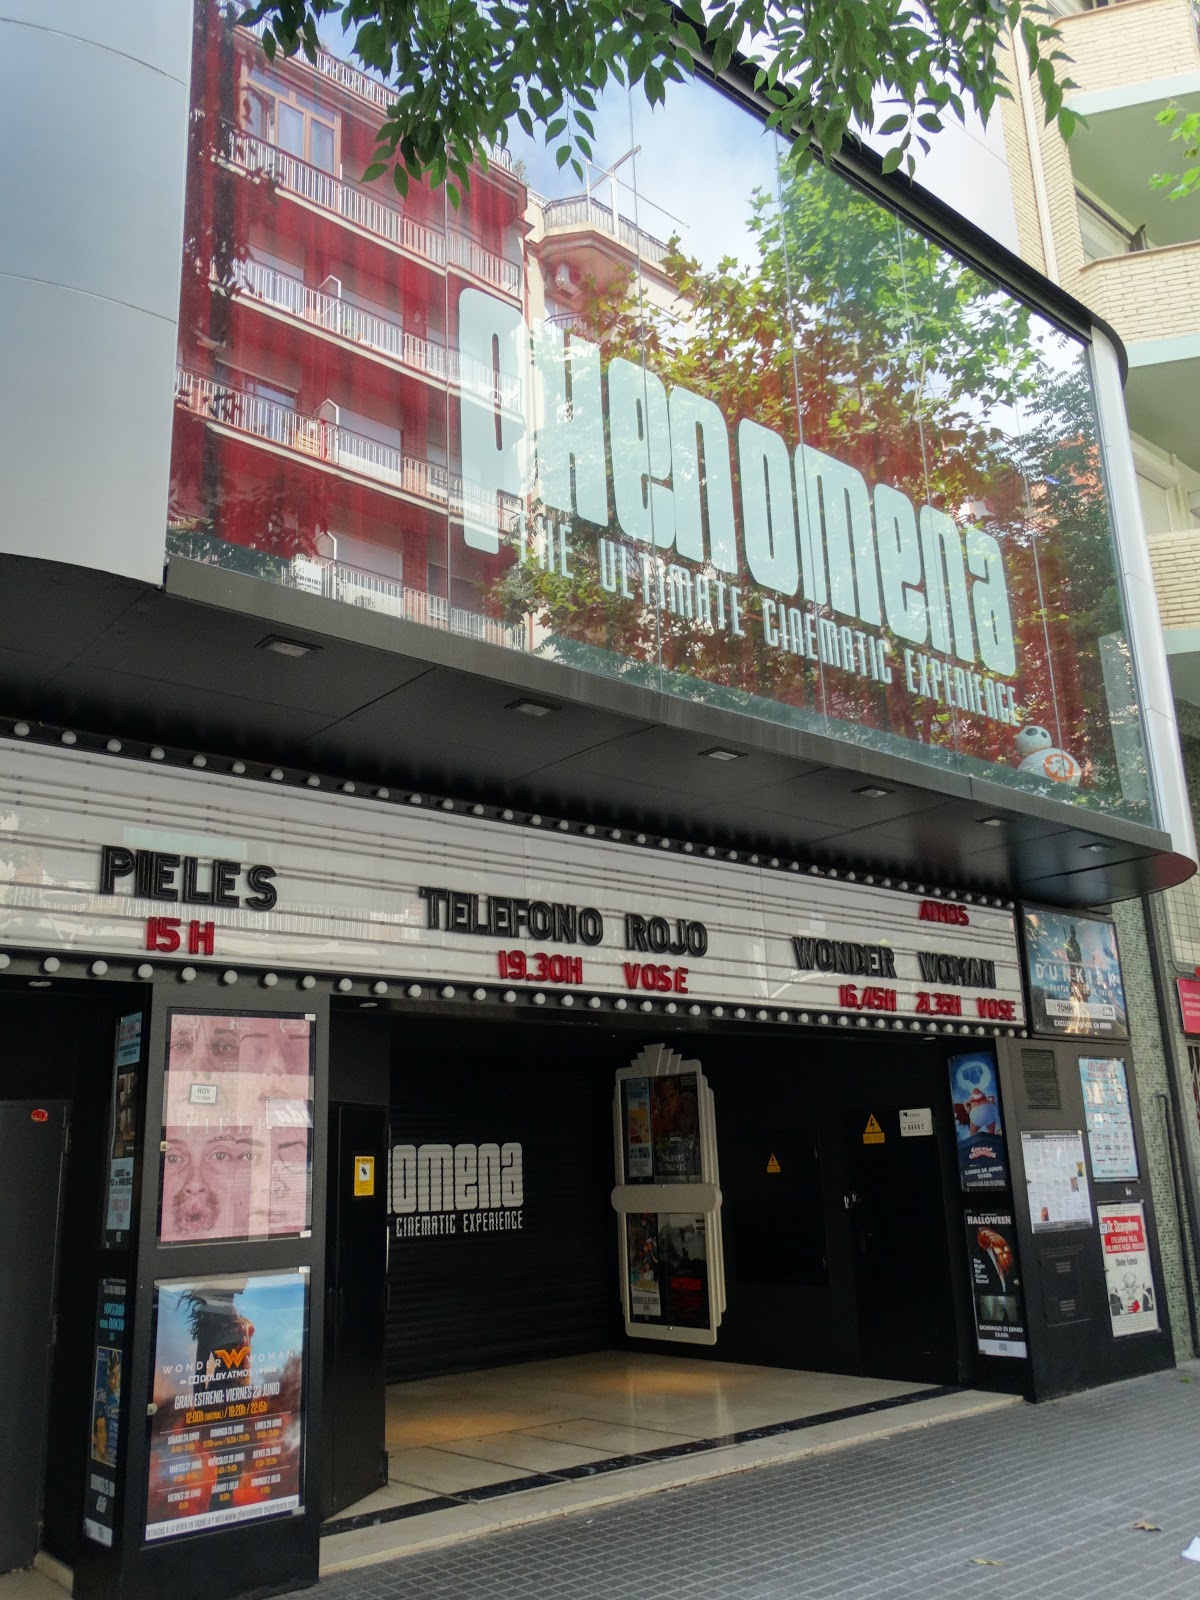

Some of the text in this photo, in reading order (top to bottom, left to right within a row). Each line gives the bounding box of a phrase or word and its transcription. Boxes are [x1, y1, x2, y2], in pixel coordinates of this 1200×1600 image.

[517, 509, 1020, 727] THE ULTIMATE CINEMATIC EXPERIENCE
[100, 844, 277, 911] PIELES
[420, 885, 708, 958] TELEFONO ROJO
[792, 936, 997, 989] WONDER WOMAN
[623, 961, 689, 994] VOSE
[975, 996, 1017, 1021] VOSE
[197, 1087, 211, 1095] HOY
[396, 1210, 523, 1237] CINEMATIC EXPERIENCE
[967, 1215, 1012, 1225] HALLOWEEN
[162, 1350, 295, 1375] WONDER WOMAN
[174, 1394, 193, 1410] GRAN
[225, 1387, 252, 1402] VIERNES
[262, 1381, 280, 1397] JUNIO
